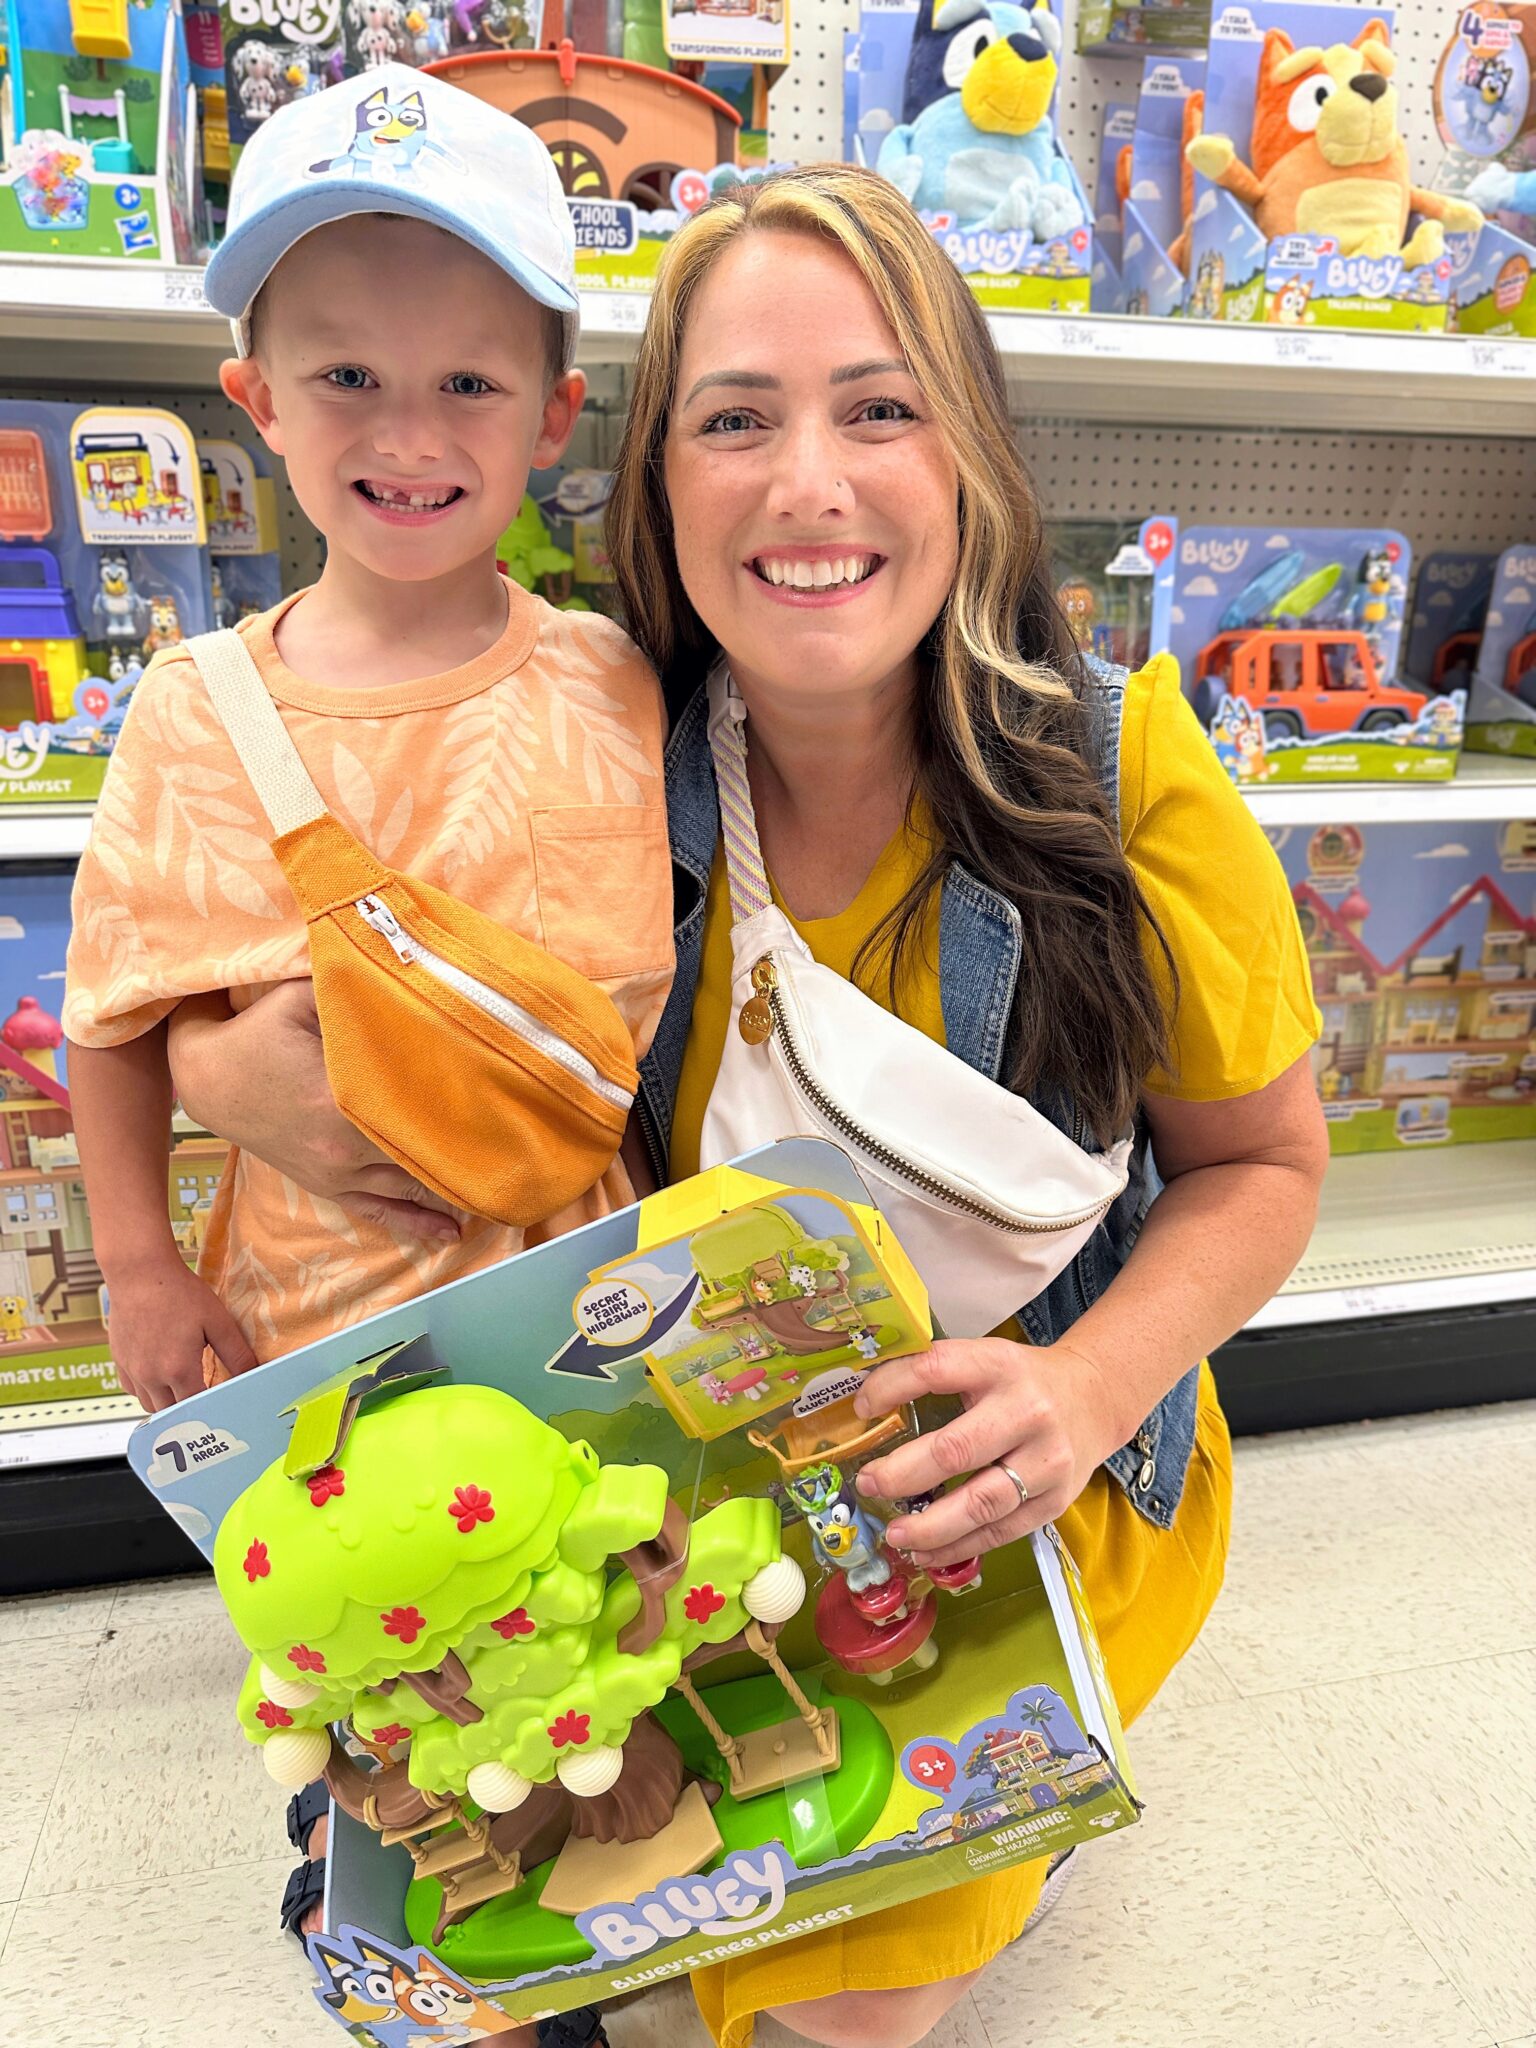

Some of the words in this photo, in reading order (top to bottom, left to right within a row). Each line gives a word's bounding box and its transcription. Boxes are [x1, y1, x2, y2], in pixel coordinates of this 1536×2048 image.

[1462, 12, 1483, 45] 4
[671, 43, 742, 56] TRANSFORMING
[744, 47, 784, 58] PLAYSET
[683, 185, 705, 203] 3+
[570, 203, 621, 228] CHOOL
[576, 226, 628, 247] IENDS
[1327, 258, 1403, 300] BLUEY
[165, 285, 206, 301] 27.9
[1149, 533, 1170, 550] 3+
[1181, 538, 1249, 573] BLUEY
[86, 695, 105, 709] 3+
[9, 780, 72, 794] PLAYSET
[583, 1288, 628, 1316] SECRET
[594, 1299, 629, 1322] FAIRY
[586, 1301, 648, 1336] HIDEAWAY
[807, 1374, 861, 1402] INCLUDES:
[798, 1395, 830, 1414] BLUEY
[832, 1391, 842, 1400] &
[155, 1440, 187, 1473] 7
[186, 1432, 217, 1452] PLAY
[192, 1441, 230, 1463] AREAS
[917, 1759, 947, 1778] 3+
[990, 1810, 1072, 1847] WARNING:
[967, 1846, 1007, 1868] CHOKING
[1005, 1834, 1042, 1853] HAZARD
[590, 1850, 786, 1957] BLUEY
[609, 1954, 701, 1991] BLUEY'S
[699, 1936, 758, 1962] TREE
[757, 1903, 855, 1944] PLAYSET
